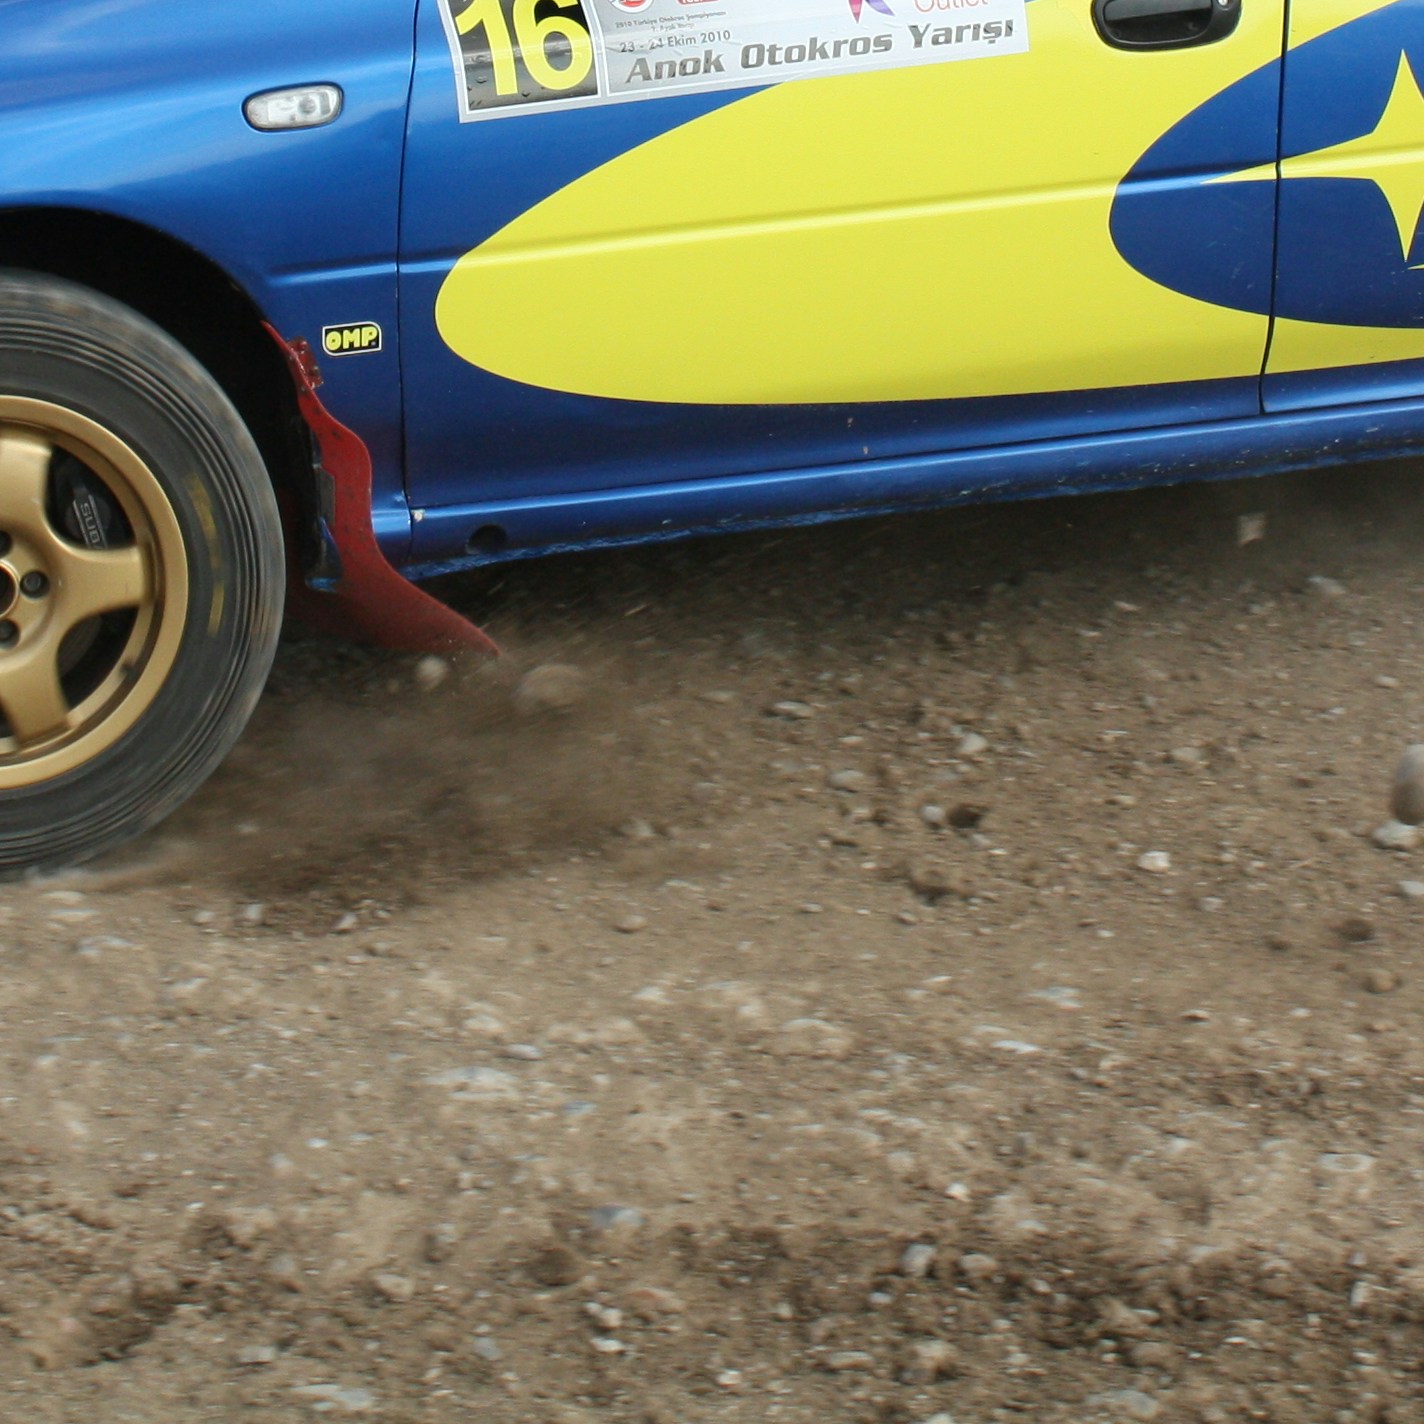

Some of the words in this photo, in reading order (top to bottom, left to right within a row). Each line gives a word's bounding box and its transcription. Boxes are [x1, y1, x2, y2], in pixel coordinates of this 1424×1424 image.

[620, 41, 636, 54] 23
[667, 33, 697, 47] Ekim
[700, 30, 731, 43] 2010
[624, 49, 727, 85] Anok
[740, 32, 894, 70] Otokros
[907, 19, 1015, 51] Yarışı
[325, 326, 379, 352] OMP
